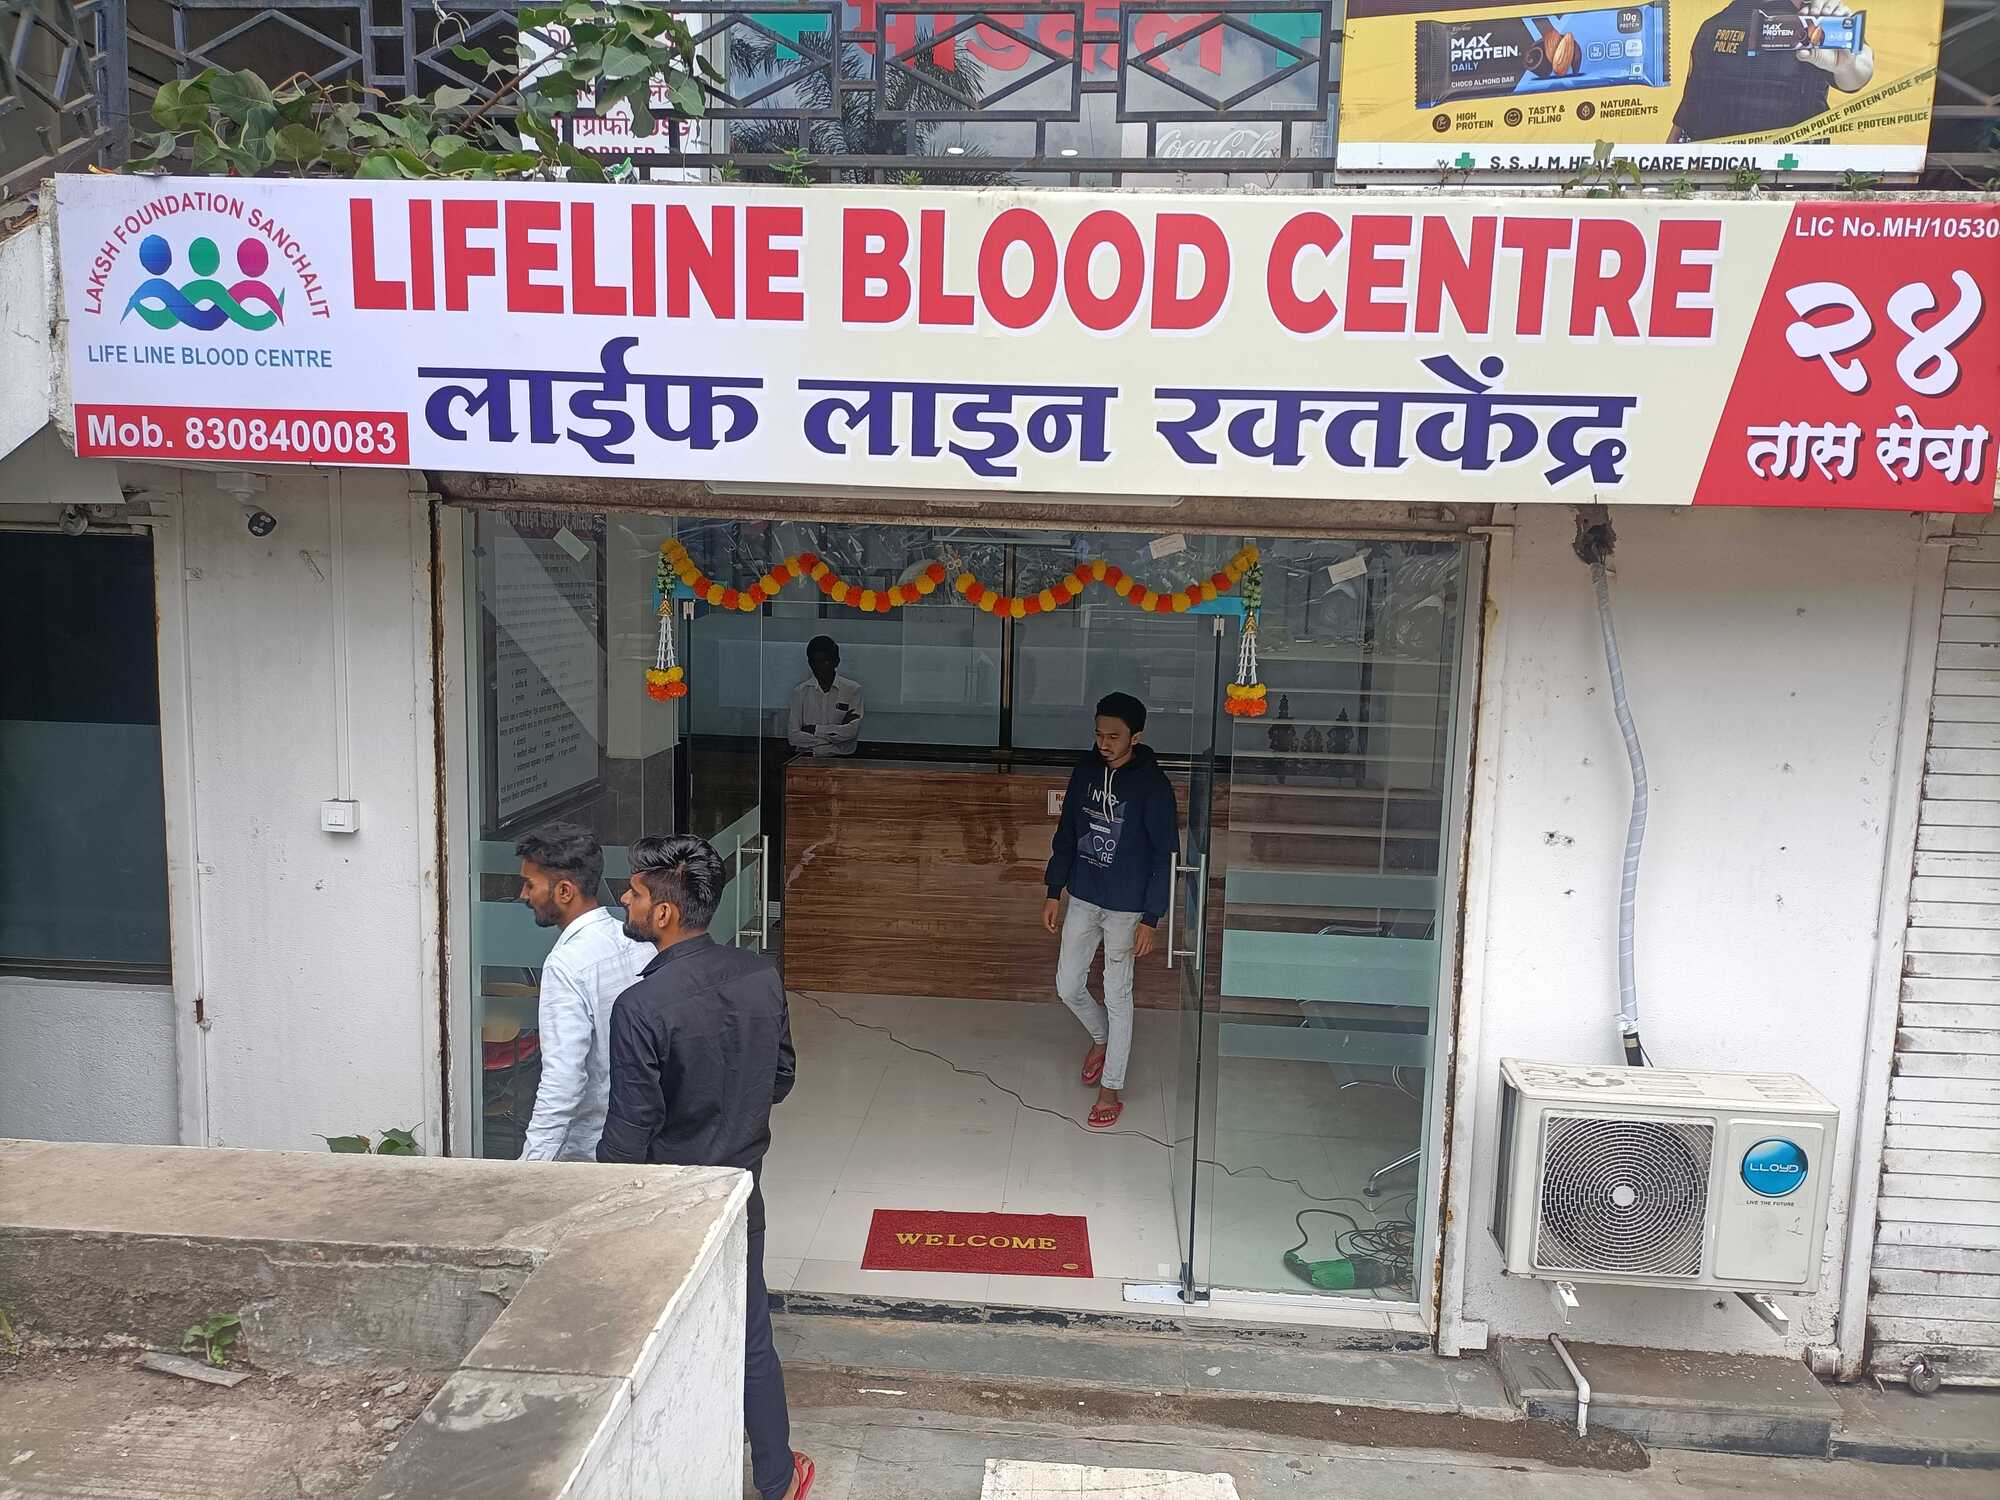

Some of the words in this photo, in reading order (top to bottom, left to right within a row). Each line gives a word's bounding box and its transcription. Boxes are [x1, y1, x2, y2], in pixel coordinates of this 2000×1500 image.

[1623, 13, 1637, 23] 10g
[1715, 29, 1746, 42] PROTEIN
[1762, 29, 1794, 37] PROTEIN
[1450, 32, 1492, 50] MAX
[1713, 41, 1739, 54] POLICE
[1450, 45, 1518, 62] PROTEIN
[1451, 62, 1479, 72] DAILY
[1451, 81, 1473, 89] CHOCO
[1474, 78, 1501, 87] ALMOND
[1501, 75, 1515, 85] BAR
[1528, 105, 1558, 116] TASTY
[1557, 104, 1566, 114] &
[1600, 98, 1643, 109] NATURAL
[1811, 112, 1841, 131] POLICE
[1843, 94, 1881, 116] PROTEIN
[1881, 80, 1913, 99] POLICE
[1456, 112, 1477, 122] HIGH
[1527, 114, 1562, 125] FILLING
[1600, 106, 1659, 119] INGREDIENTS
[1455, 120, 1494, 131] PROTEIN
[1857, 117, 1896, 130] PROTEIN
[1897, 111, 1929, 124] POLICE
[1639, 156, 1685, 170] CARE
[1687, 156, 1762, 170] MEDICAL
[1795, 216, 1834, 237] LIC
[1842, 216, 2000, 239] No.MH/10530
[84, 240, 121, 315] LAKSH
[114, 191, 244, 244] FOUNDATION
[248, 209, 331, 319] SANCHALIT
[349, 197, 805, 322] LIFELINE
[841, 207, 1231, 331] BLOOD
[1266, 211, 1722, 338] CENTRE
[1785, 269, 1983, 397] २४
[88, 345, 127, 363] LIFE
[134, 346, 175, 364] LINE
[182, 347, 249, 367] BLOOD
[255, 350, 332, 368] CENTRE
[418, 336, 764, 464] लाईफ
[798, 378, 1119, 478] लाइन
[1154, 353, 1638, 486] रक्तकेंद्र
[87, 414, 174, 449] Mob.
[185, 417, 397, 455] 8308400083
[1747, 421, 1862, 481] तास
[1876, 404, 1990, 483] सेवा
[1092, 835, 1116, 852] CO
[1100, 852, 1113, 864] RE
[1749, 1162, 1799, 1173] LLOYD
[895, 1232, 1057, 1250] WELCOME
